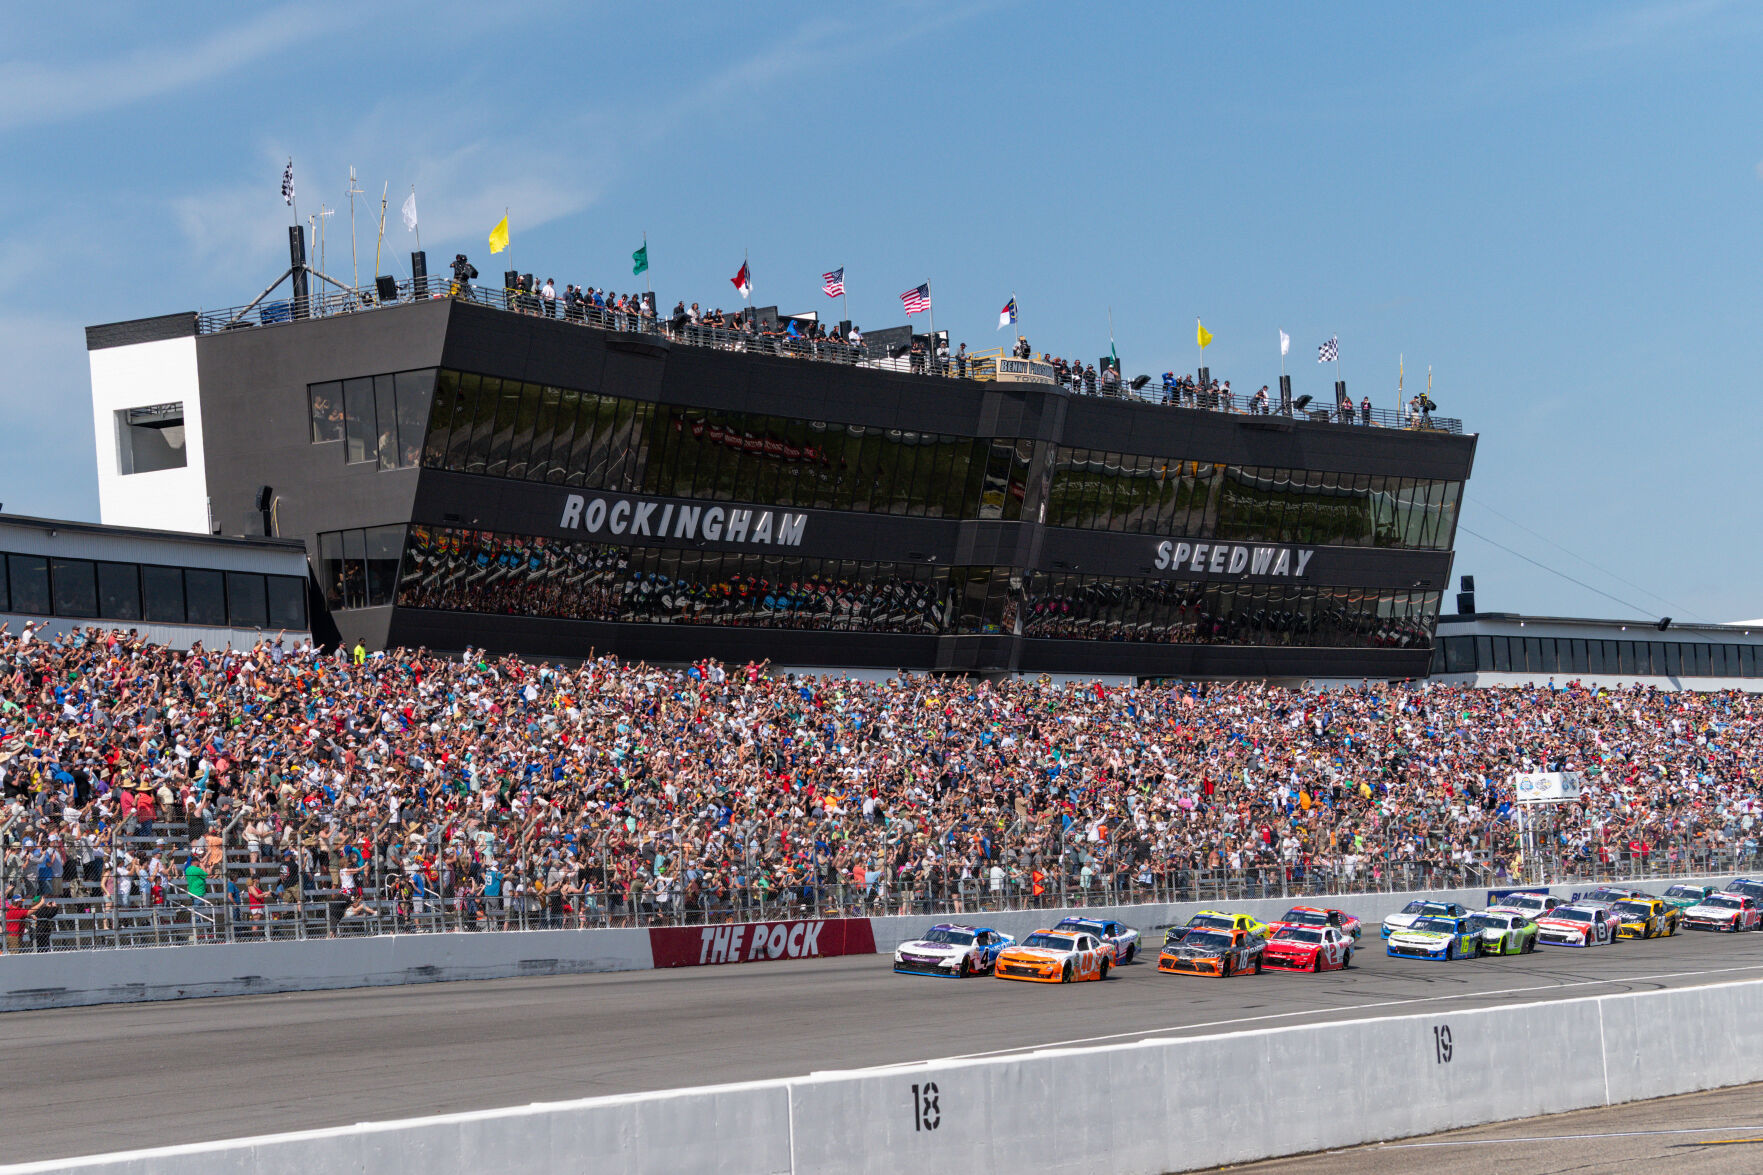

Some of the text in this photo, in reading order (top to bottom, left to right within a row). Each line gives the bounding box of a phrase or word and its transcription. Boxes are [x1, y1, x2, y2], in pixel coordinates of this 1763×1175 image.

[1000, 360, 1028, 374] BENNY
[560, 494, 808, 546] ROCKINGHAM
[1154, 540, 1314, 577] SPEEDWAY
[700, 921, 825, 964] THE ROCK
[981, 946, 990, 969] 4
[1329, 943, 1338, 963] 2
[1461, 935, 1470, 953] 16
[1238, 949, 1249, 970] 18
[1434, 1024, 1453, 1064] 19
[912, 1081, 941, 1131] 18
